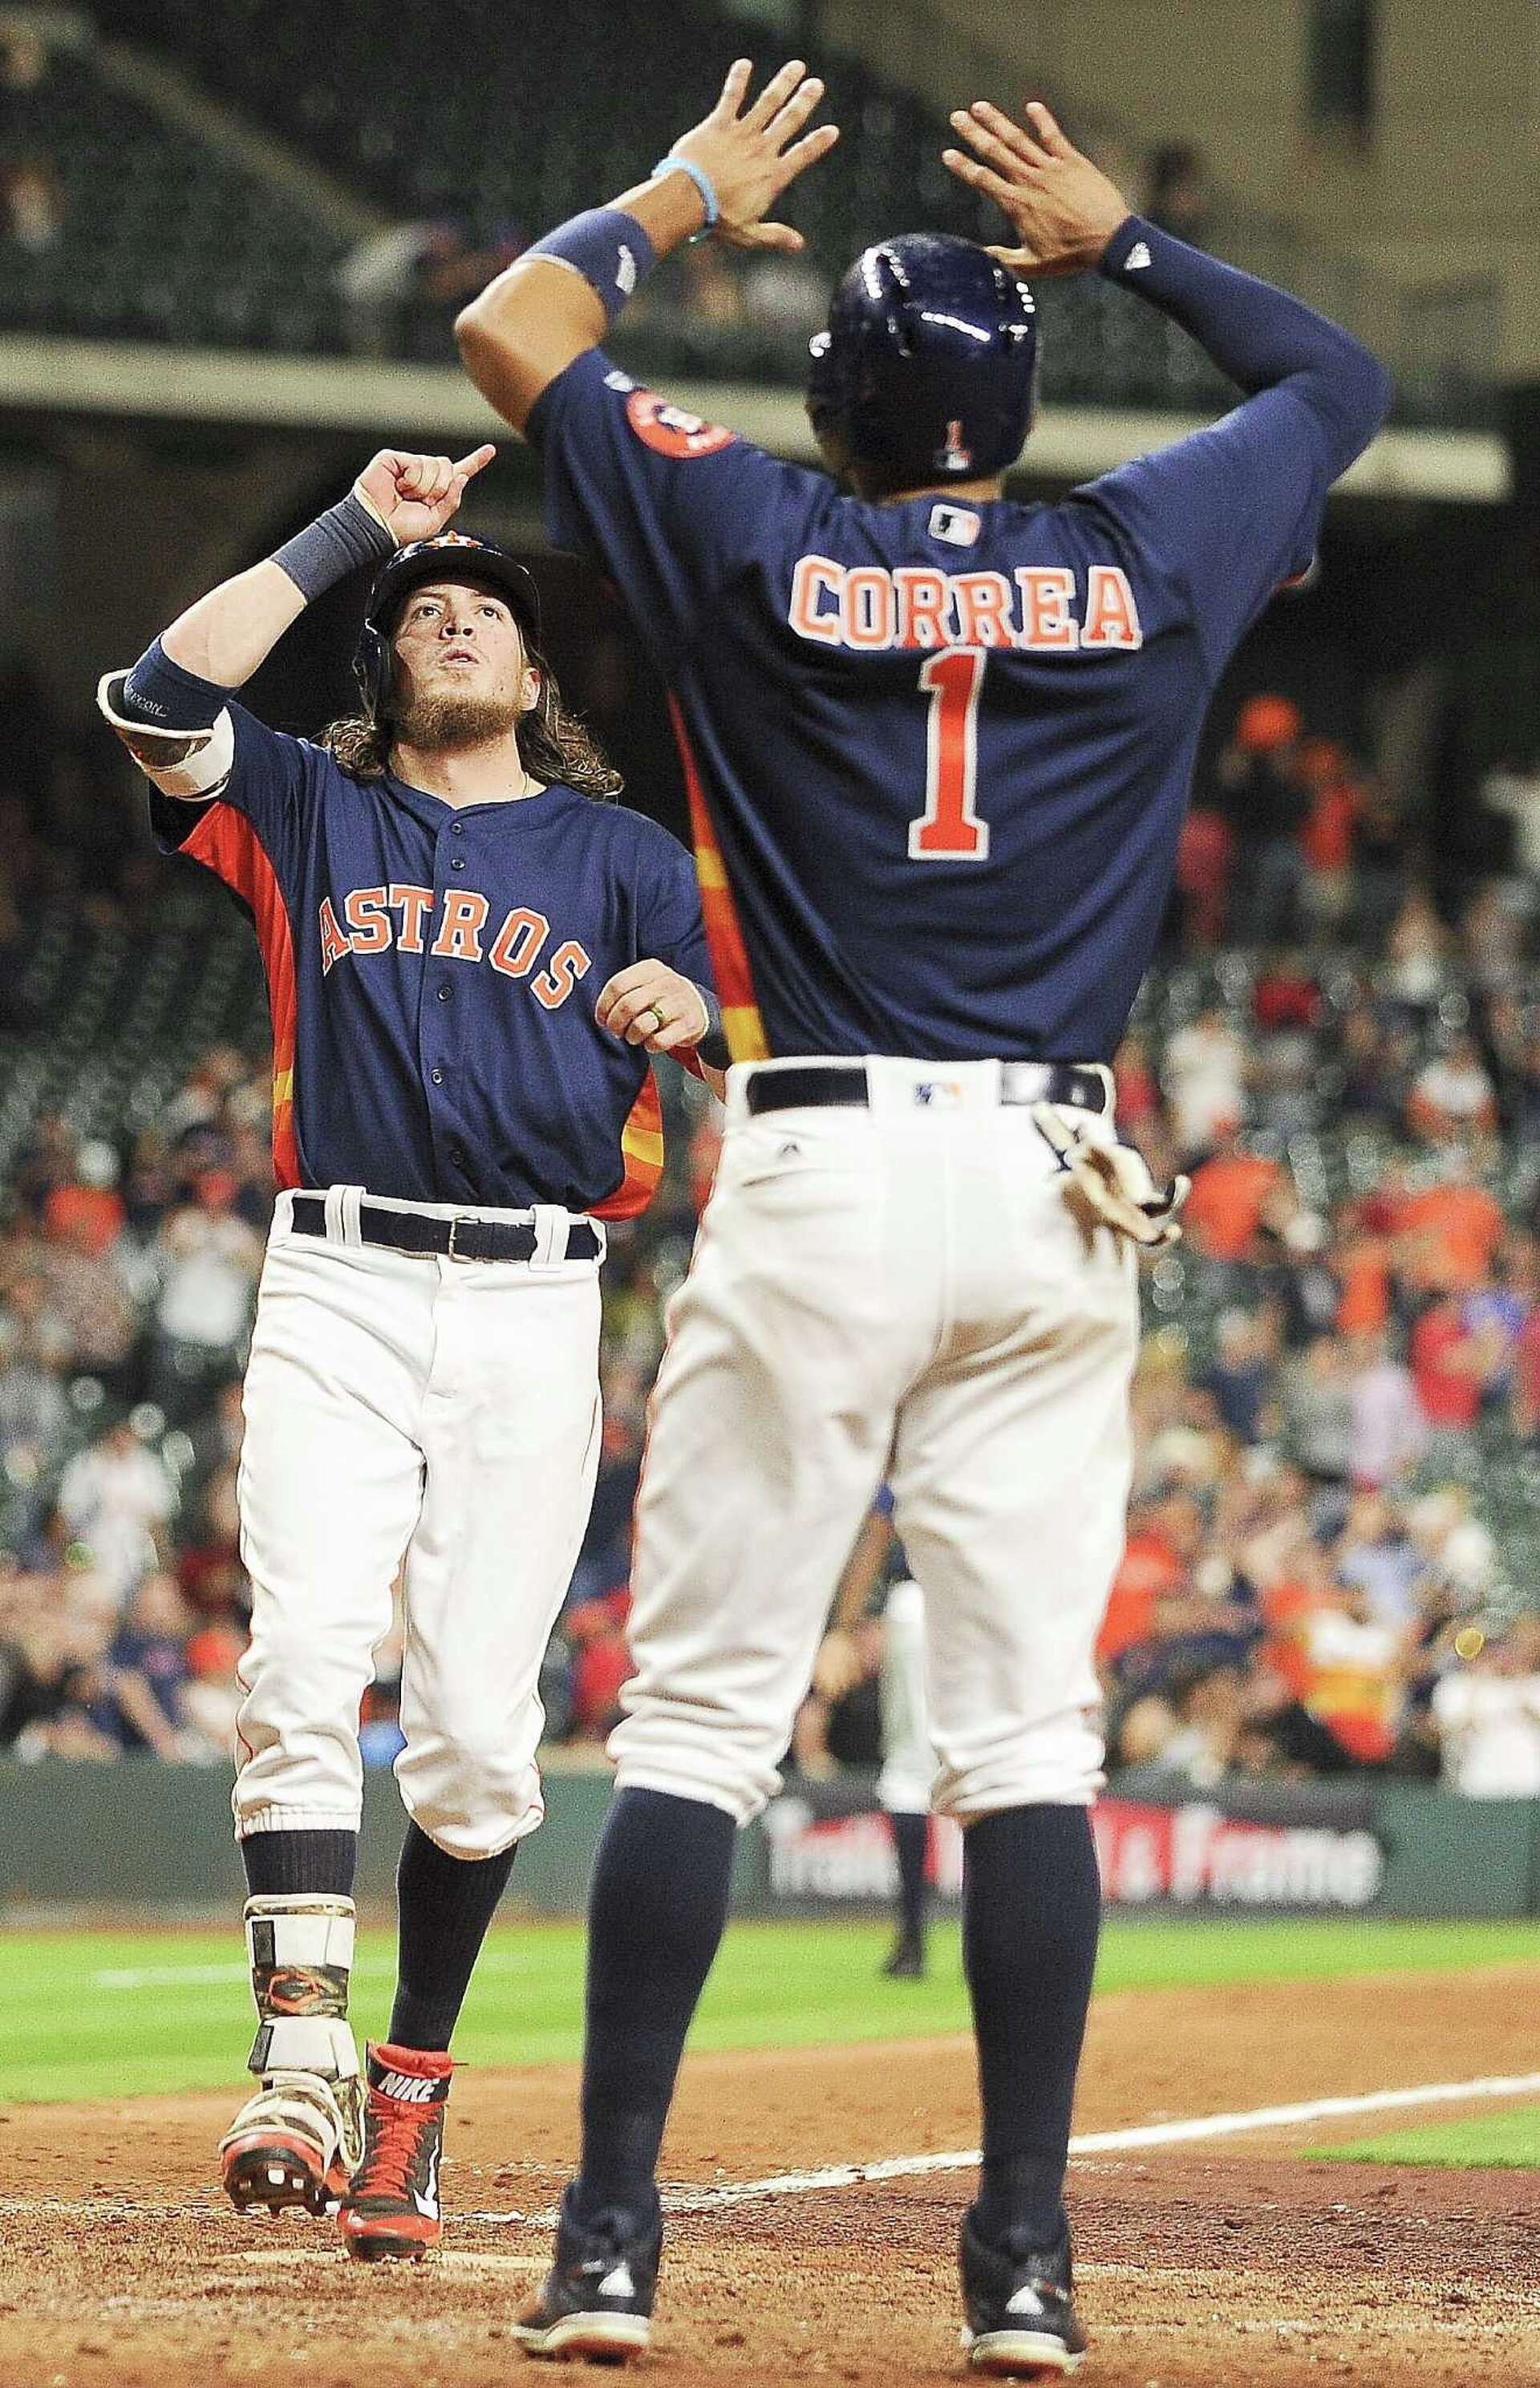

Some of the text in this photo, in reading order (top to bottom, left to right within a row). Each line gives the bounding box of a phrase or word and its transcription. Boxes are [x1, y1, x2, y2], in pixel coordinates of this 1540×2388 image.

[788, 555, 1143, 651] CORREA
[908, 645, 990, 861] 1
[318, 882, 593, 1011] ASTROS
[1173, 1802, 1381, 1906] Frame
[378, 2071, 440, 2103] NIKE
